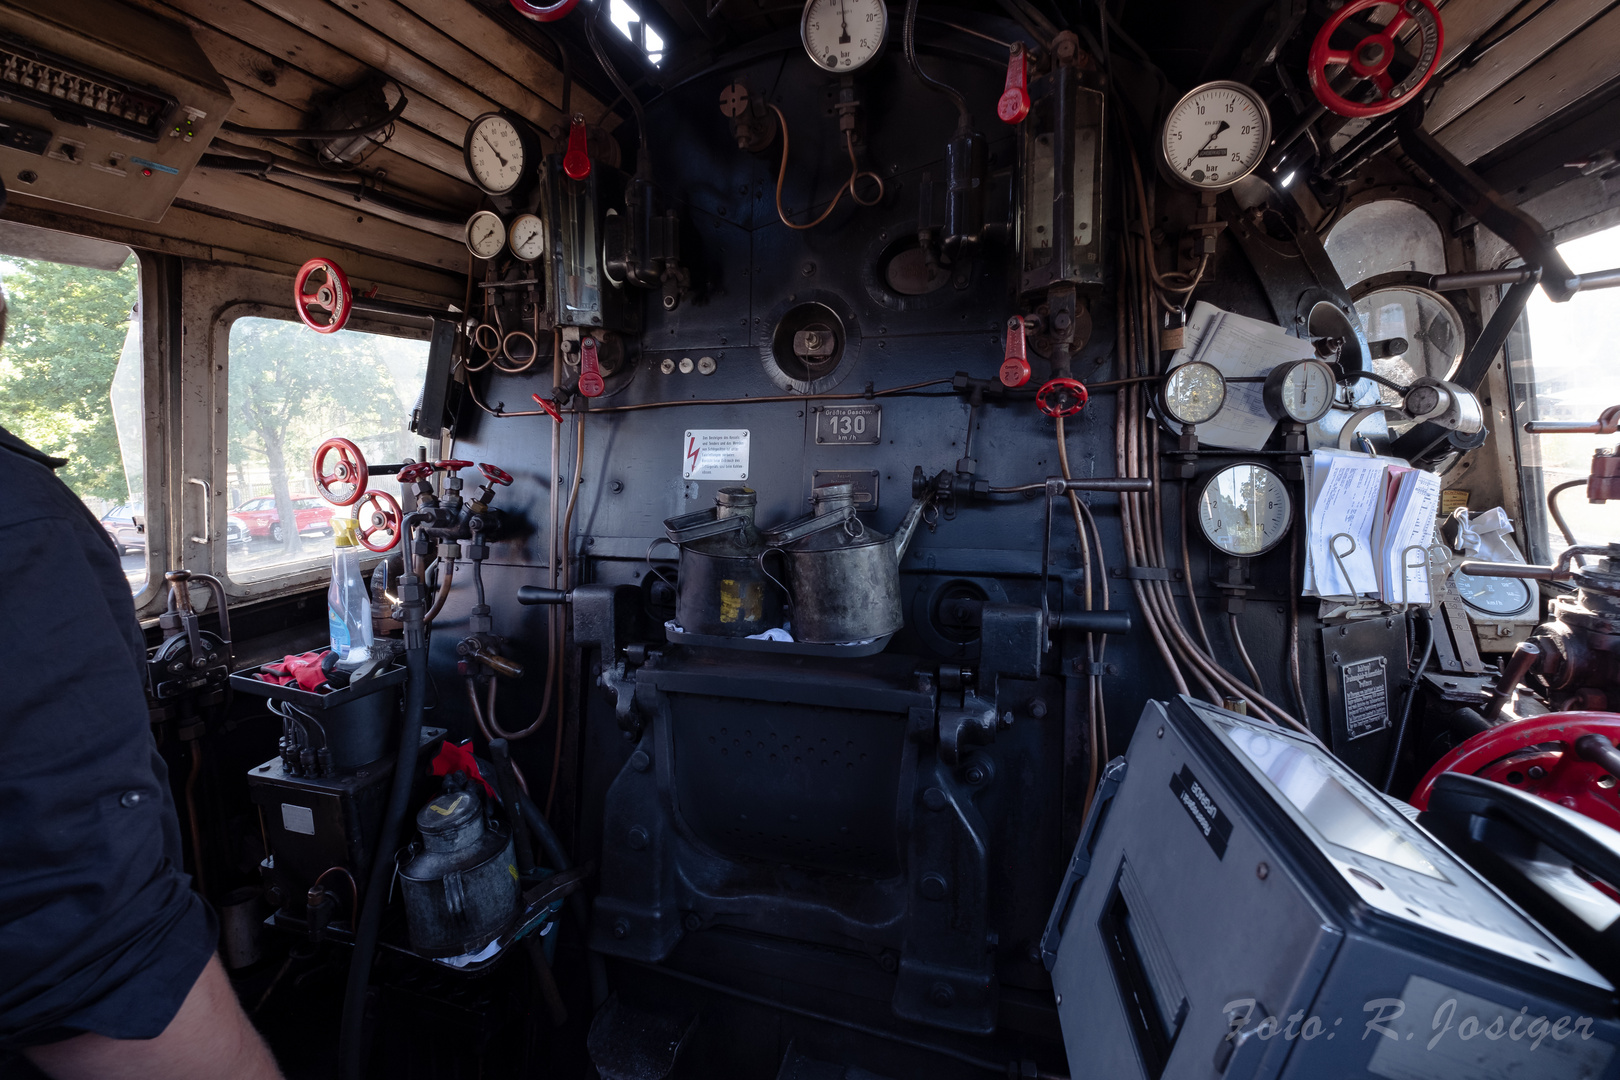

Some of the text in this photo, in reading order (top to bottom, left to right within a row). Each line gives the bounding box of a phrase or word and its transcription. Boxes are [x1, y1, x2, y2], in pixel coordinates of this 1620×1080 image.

[866, 14, 873, 22] 20
[816, 22, 819, 30] 5
[860, 39, 867, 48] 25
[1197, 106, 1205, 115] 10
[1225, 104, 1234, 112] 15
[1241, 125, 1250, 134] 20
[1178, 131, 1182, 140] 5
[1231, 153, 1240, 162] 25
[830, 416, 865, 434] 130
[1269, 501, 1273, 509] 8
